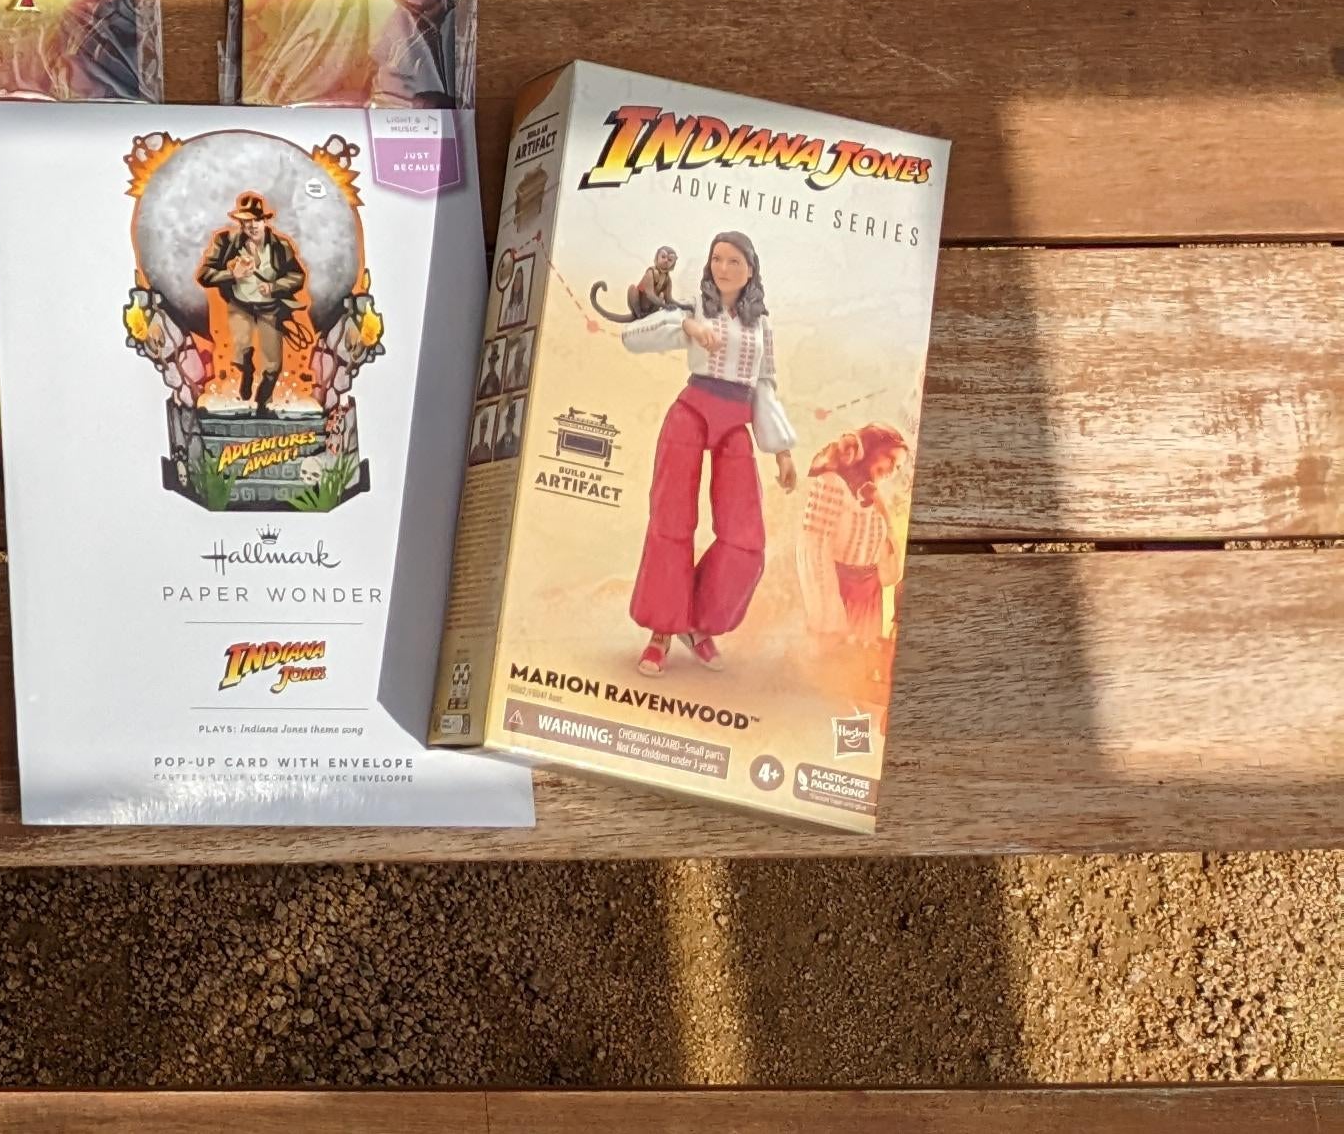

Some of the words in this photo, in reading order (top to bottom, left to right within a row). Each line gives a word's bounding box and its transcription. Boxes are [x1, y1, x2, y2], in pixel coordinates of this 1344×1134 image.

[404, 152, 429, 160] JUST
[515, 129, 558, 162] ARTIFACT
[578, 105, 818, 190] INDIANA
[803, 139, 933, 192] JONES
[393, 163, 442, 172] BECAUSE
[671, 174, 815, 224] ADVENTURE
[832, 209, 921, 247] SERIES
[217, 431, 317, 474] ADVENTURES
[242, 446, 300, 478] AWAIT!
[558, 465, 587, 479] BUILD
[587, 473, 602, 482] AN
[534, 471, 623, 503] ARTIFACT
[200, 539, 342, 576] Hallmark
[162, 586, 249, 602] PAPER
[266, 587, 383, 603] WONDER
[218, 640, 327, 692] INDIANA
[269, 665, 327, 694] JONES
[509, 662, 601, 698] MARION
[198, 724, 237, 734] PLAYS:
[240, 724, 279, 734] Indiana
[280, 724, 308, 734] Jones
[310, 724, 340, 734] theme
[341, 726, 364, 736] song
[538, 714, 614, 745] WARNING:
[618, 727, 650, 745] CHOKING
[837, 724, 872, 739] Hasbro
[154, 757, 217, 768] POP-UP
[224, 757, 269, 768] CARD
[277, 757, 320, 768] WITH
[328, 757, 413, 768] ENVELOPE
[616, 742, 630, 754] Not
[629, 745, 641, 756] for
[641, 747, 670, 764] children
[670, 754, 693, 768] under
[321, 773, 349, 783] AVEC
[352, 773, 414, 783] ENVELOPPE
[758, 762, 780, 783] 4+
[811, 768, 871, 790] PLASTIC-FREE
